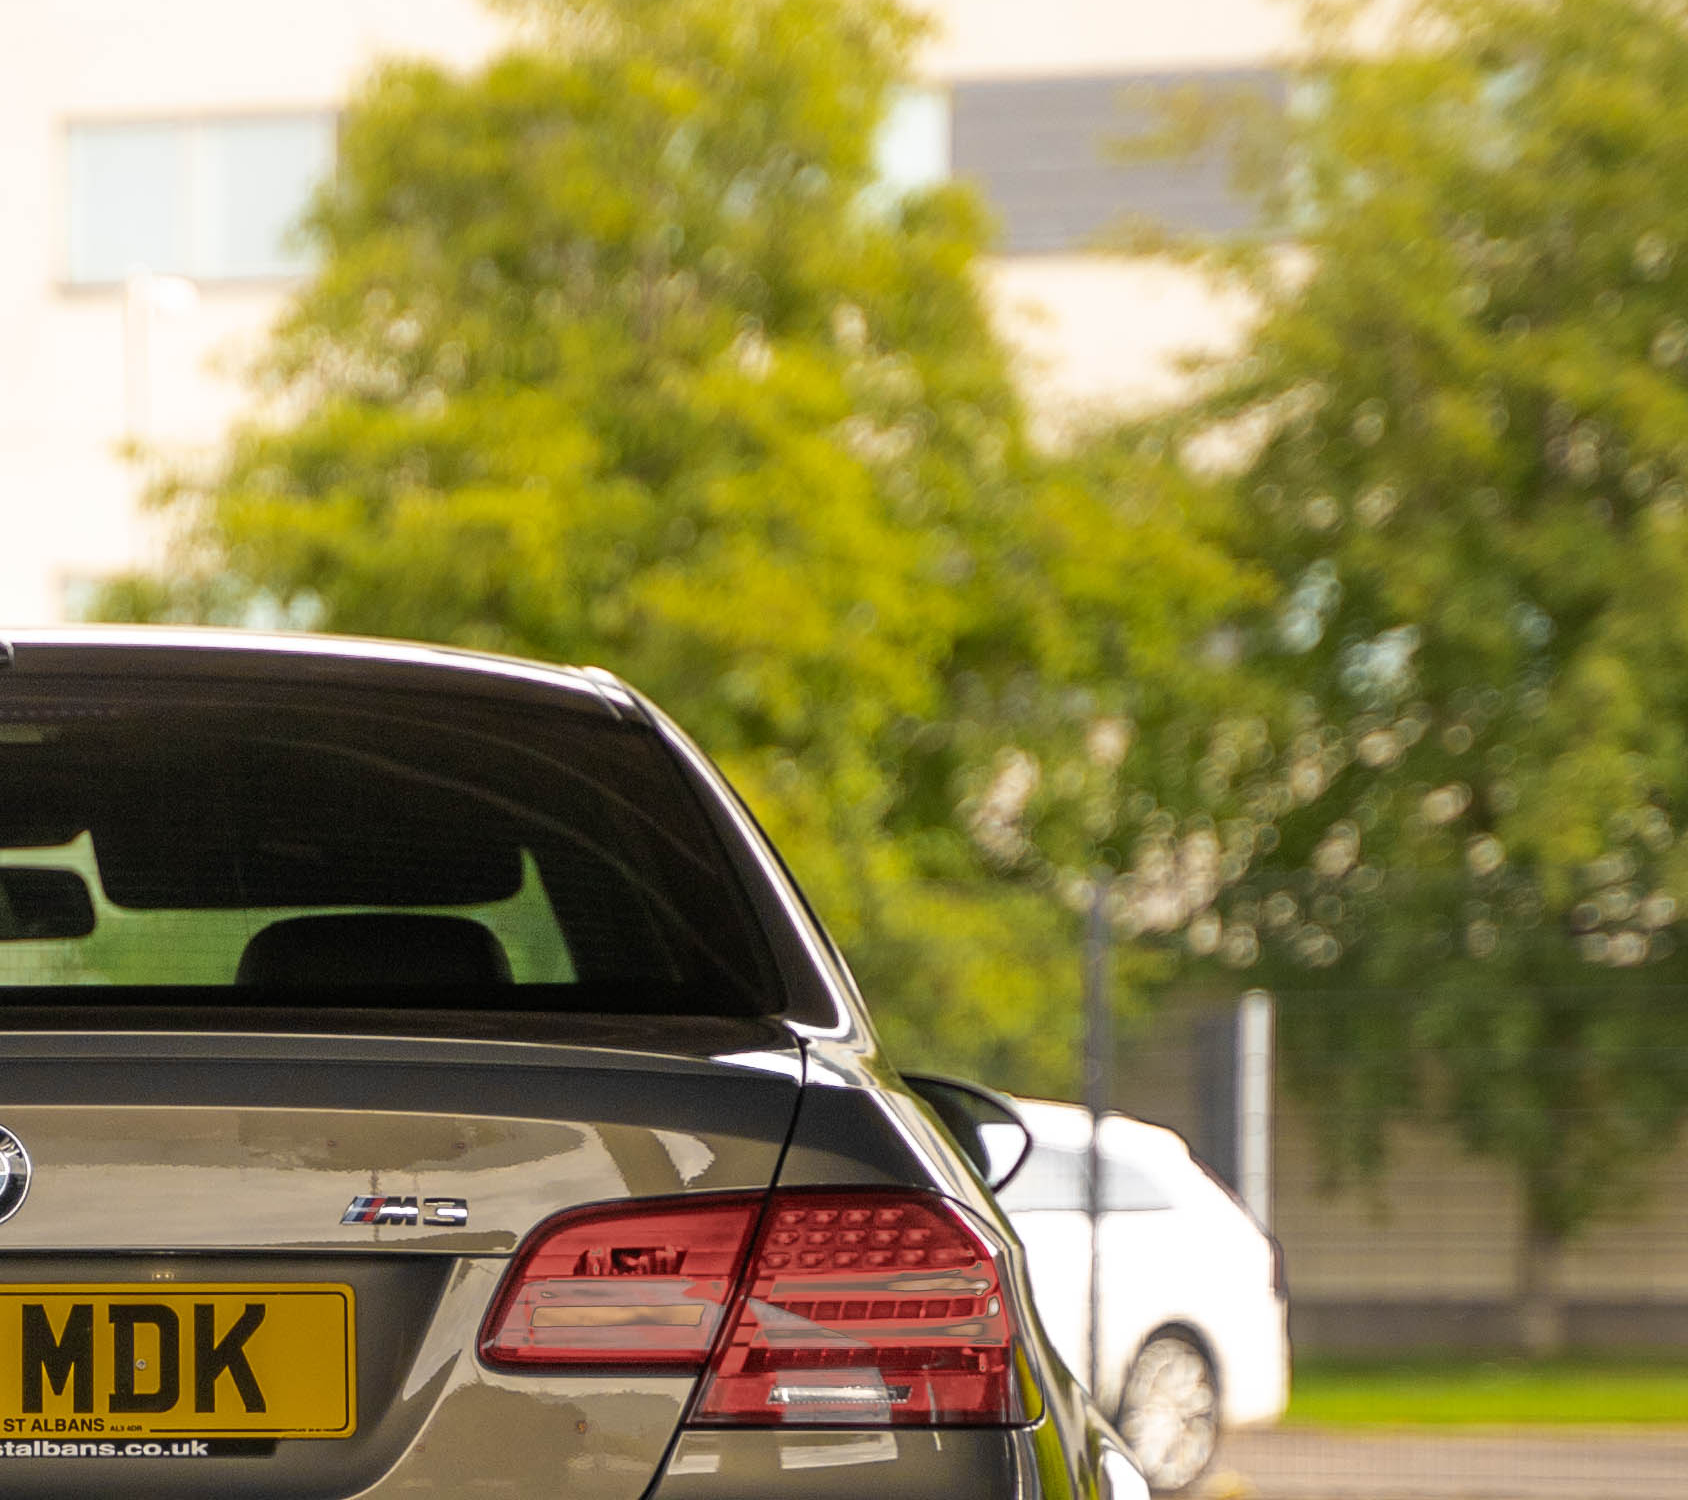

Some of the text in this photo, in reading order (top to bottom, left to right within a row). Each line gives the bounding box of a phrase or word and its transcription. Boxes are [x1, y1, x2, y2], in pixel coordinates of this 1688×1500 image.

[372, 1196, 468, 1227] M3
[22, 1303, 267, 1414] MDK
[3, 1418, 27, 1433] ST
[31, 1418, 105, 1433] ALBANS
